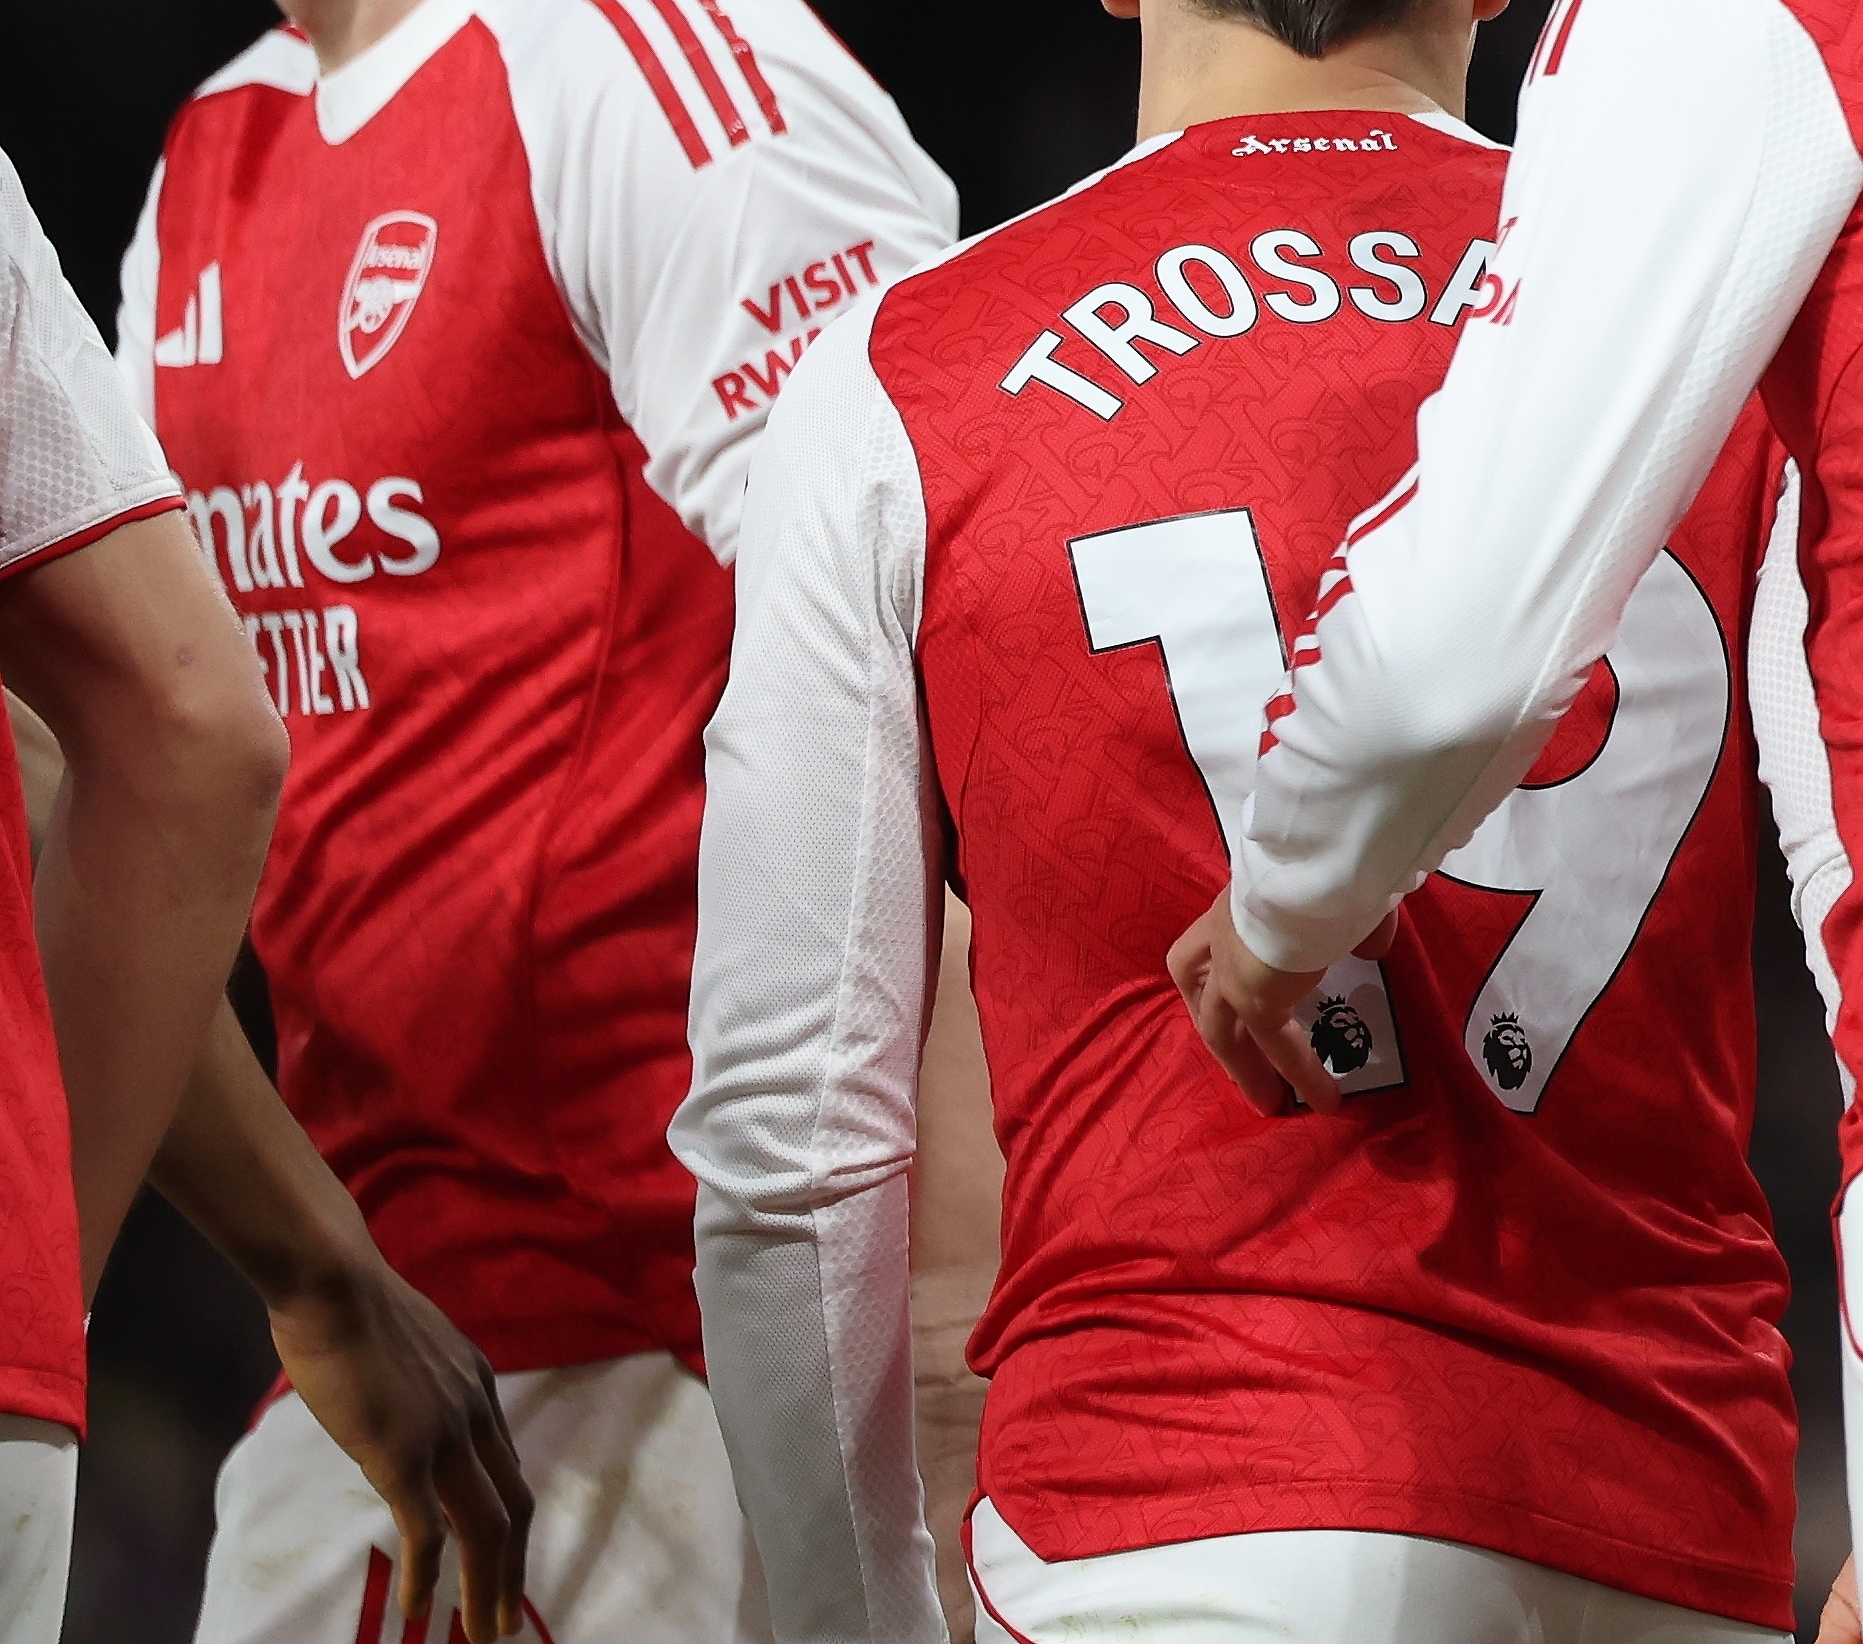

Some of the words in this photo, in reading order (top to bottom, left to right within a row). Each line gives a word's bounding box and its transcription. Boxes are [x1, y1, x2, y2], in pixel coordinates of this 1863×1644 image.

[1231, 128, 1399, 157] Arsenal
[739, 239, 880, 336] VISIT
[711, 327, 823, 422] RW
[1066, 504, 1733, 1118] 19
